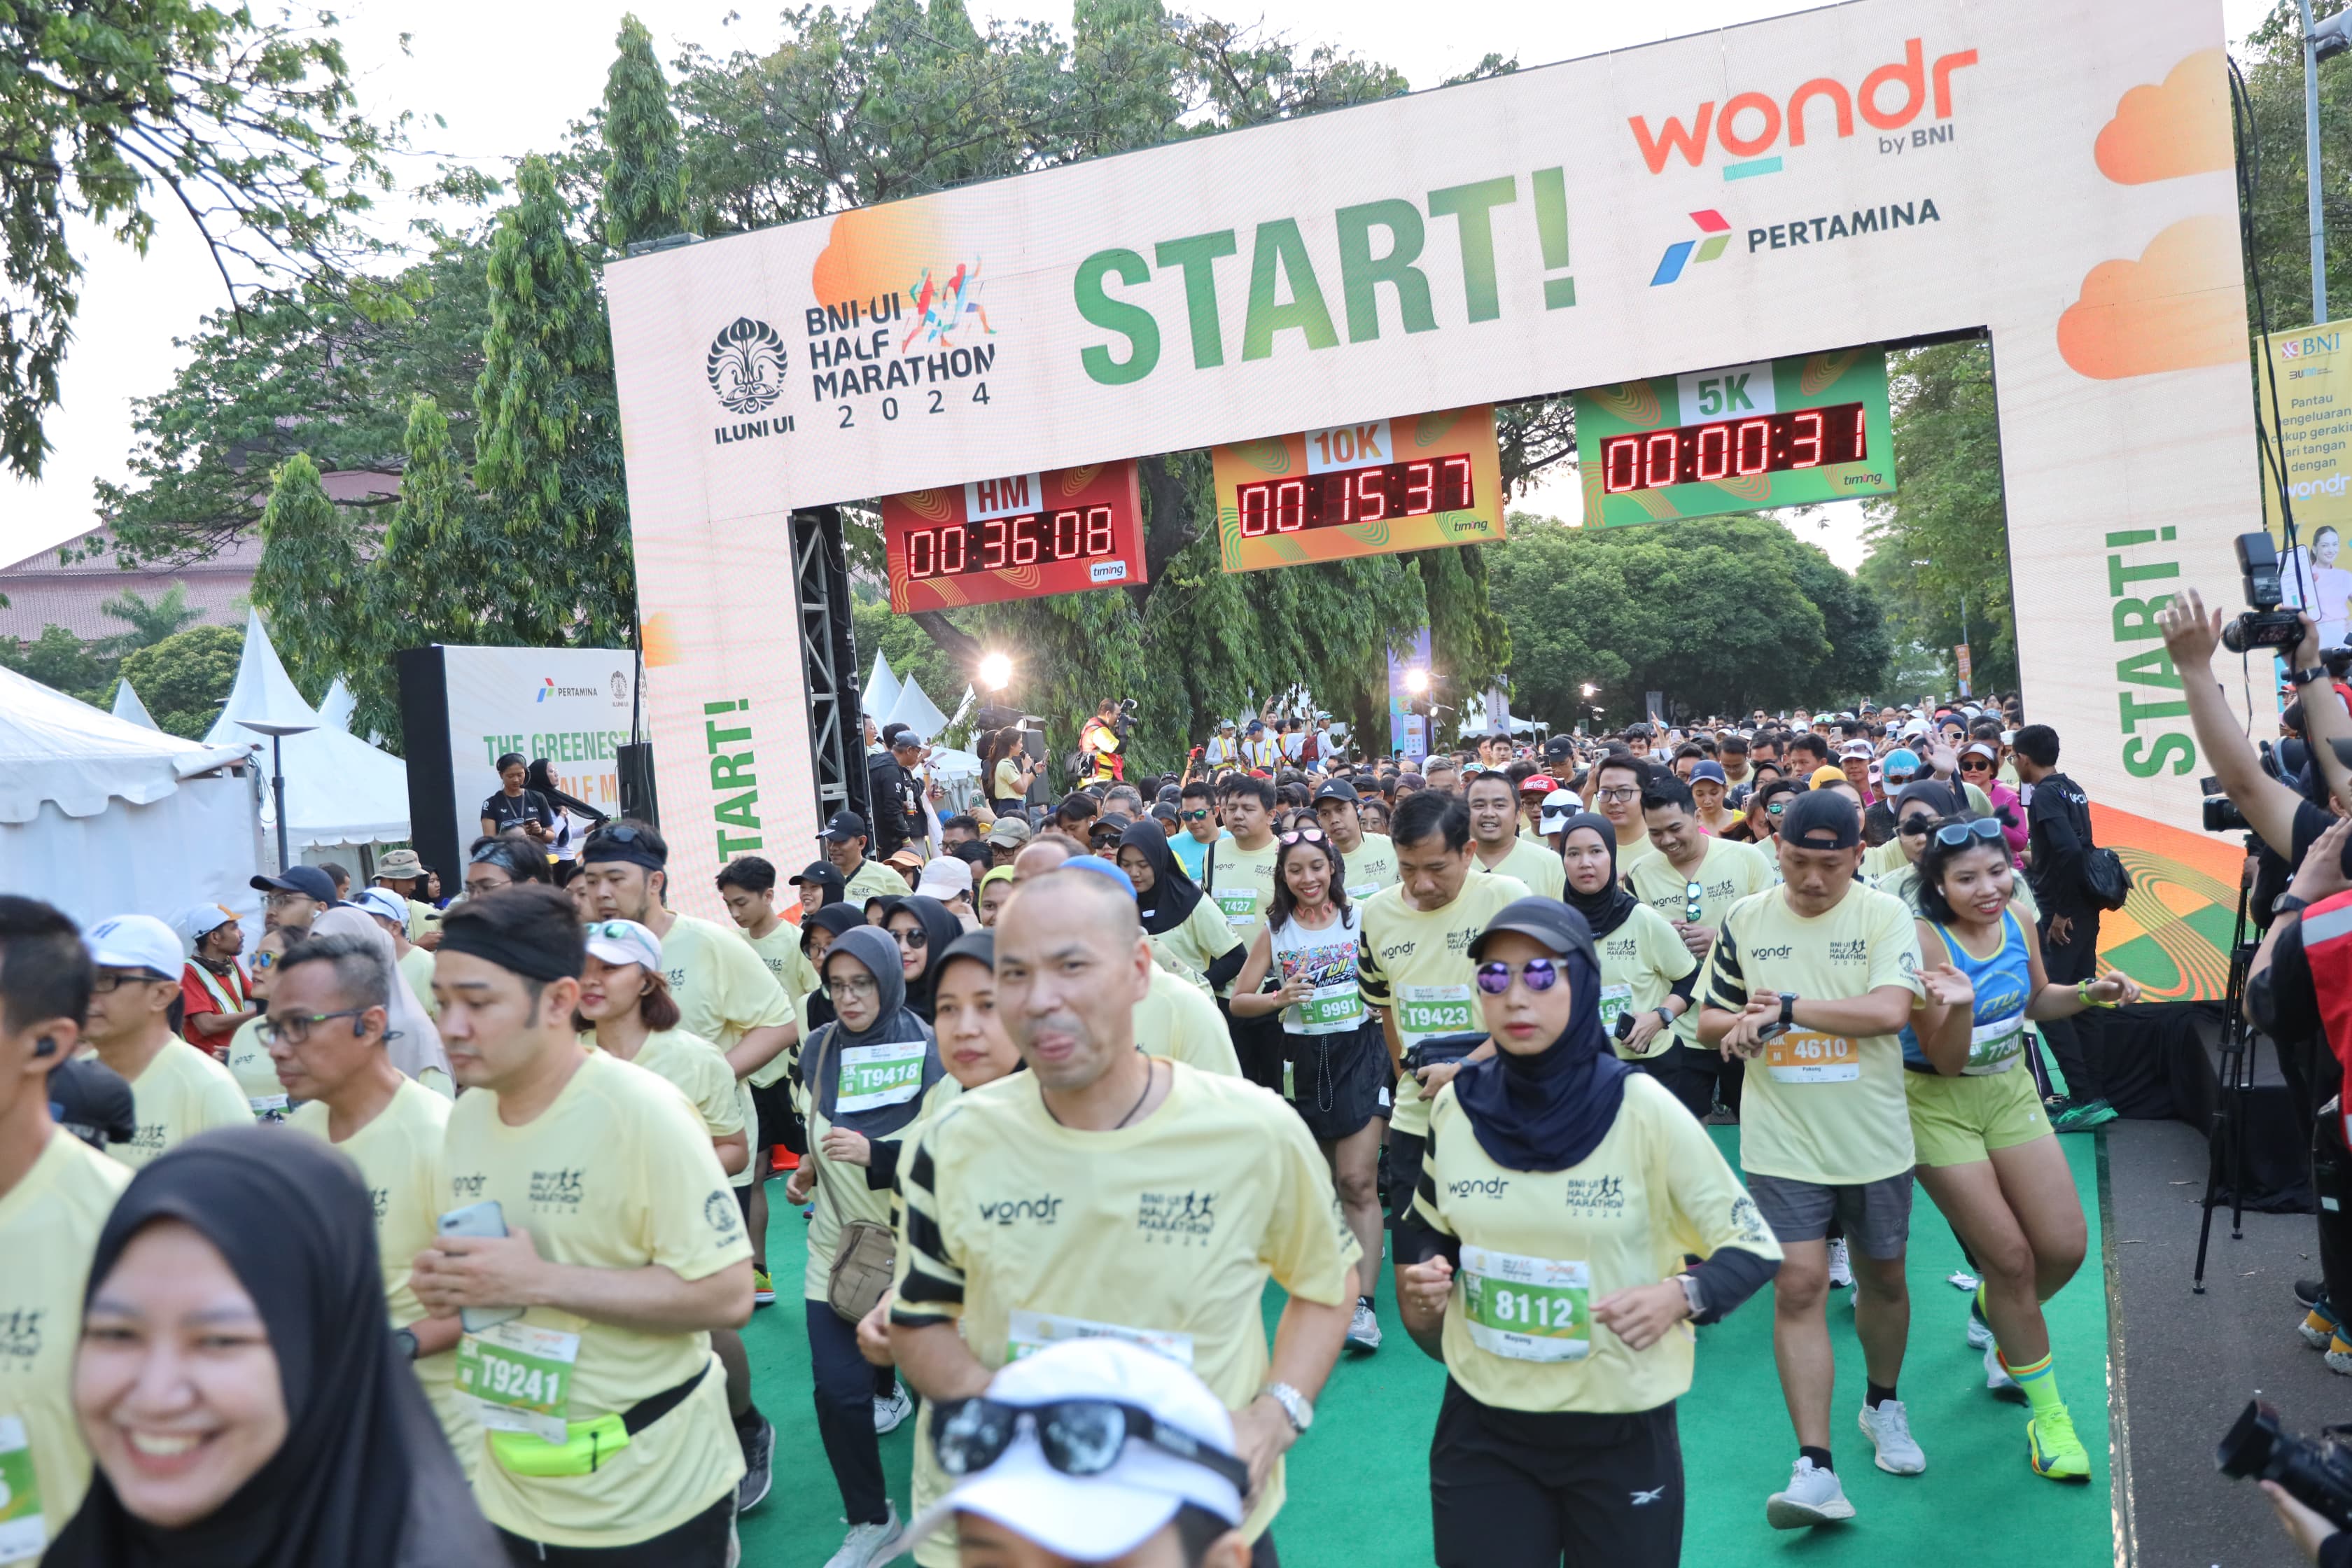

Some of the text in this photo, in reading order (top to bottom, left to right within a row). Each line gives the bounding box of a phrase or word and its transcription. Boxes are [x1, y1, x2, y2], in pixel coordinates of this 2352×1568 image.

[1628, 37, 1977, 175] wondr
[1879, 124, 1954, 155] by BNI
[1748, 199, 1940, 253] PERTAMINA
[1074, 166, 1576, 385] START!
[810, 328, 890, 370] HALF
[2302, 332, 2340, 356] BNI
[813, 343, 996, 402] MARATHON
[839, 382, 990, 429] 2024
[1698, 373, 1754, 416] 5K
[2291, 394, 2333, 409] Pantau
[2280, 407, 2352, 426] engeluaran
[715, 415, 794, 444] ILUNI UI
[1315, 424, 1382, 465] 10K
[1607, 408, 1865, 493] 00:00:31
[2285, 440, 2346, 457] ari tangan
[2291, 458, 2336, 472] dengan
[1844, 472, 1883, 486] timing
[977, 475, 1030, 513] HM
[1242, 458, 1469, 537] 00:15:37
[1453, 519, 1489, 532] timing
[910, 506, 1112, 578] 00:36:08
[1093, 564, 1124, 579] timing
[2106, 526, 2196, 778] START!
[558, 687, 598, 697] PERTAMINA
[483, 734, 524, 766] THE
[560, 776, 594, 804] ALF
[704, 699, 763, 863] TART!
[1224, 901, 1250, 912] 7427
[1652, 895, 1683, 906] wondr
[1381, 941, 1415, 958] wondr
[1751, 945, 1793, 958] wondr
[1302, 1002, 1313, 1011] 5K
[1322, 998, 1357, 1017] 9991
[1408, 1007, 1469, 1026] T9423
[1773, 1051, 1782, 1061] M
[1794, 1037, 1848, 1058] 4610
[1988, 1034, 2019, 1060] 7730
[860, 1063, 918, 1088] T9418
[1448, 1177, 1509, 1194] wondr
[1568, 1190, 1593, 1198] HALF
[980, 1194, 1063, 1219] wondr
[1567, 1198, 1623, 1208] MARATHON
[1495, 1289, 1573, 1328] 8112
[481, 1354, 559, 1405] T9241
